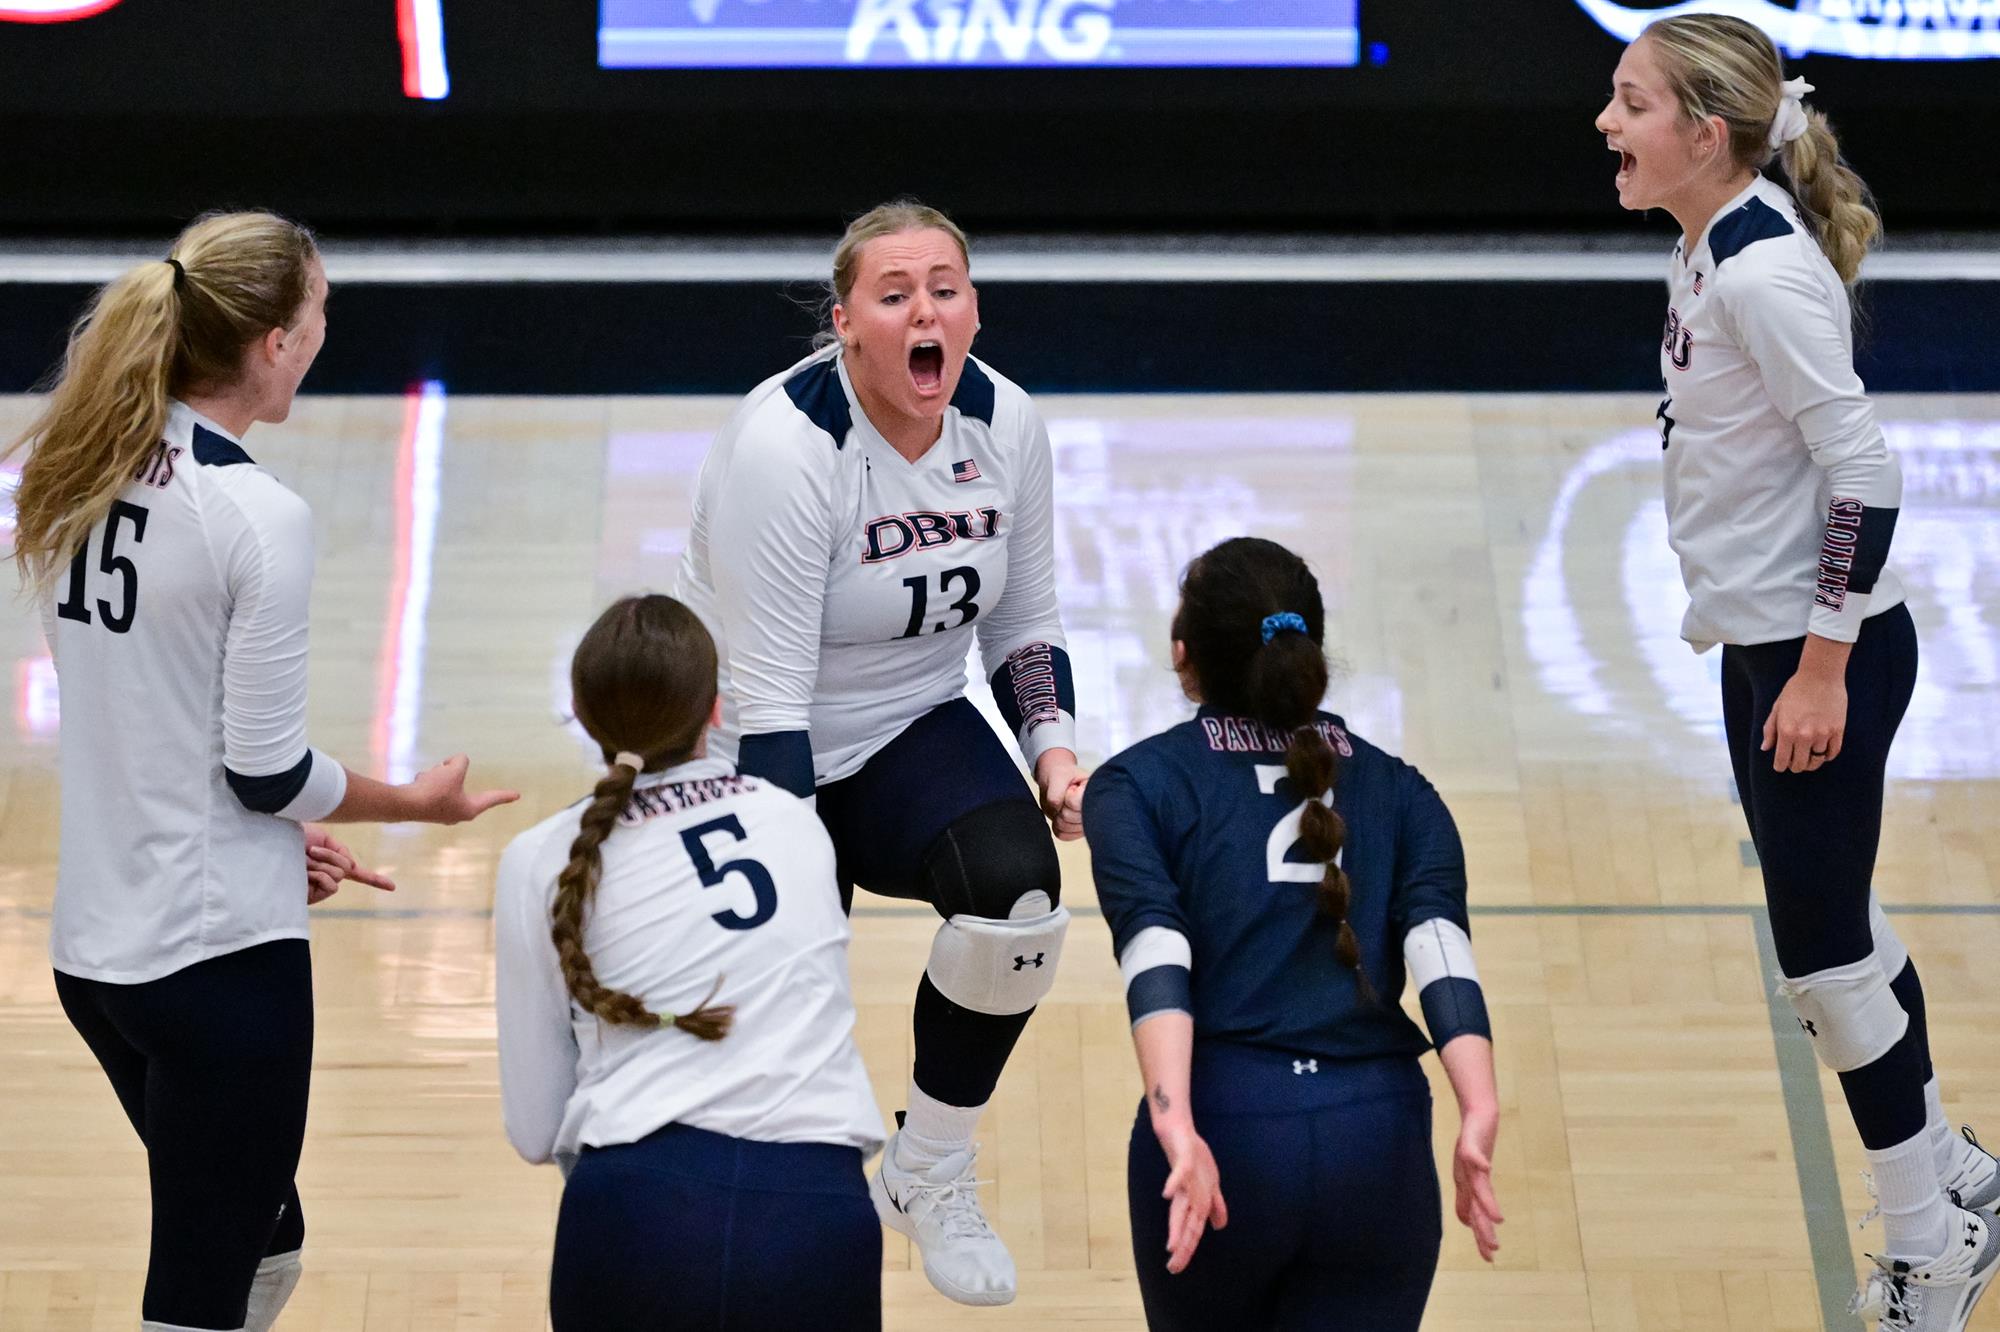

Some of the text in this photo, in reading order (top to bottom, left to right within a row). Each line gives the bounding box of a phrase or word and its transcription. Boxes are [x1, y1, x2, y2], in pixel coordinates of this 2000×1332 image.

[57, 499, 149, 634] 15
[861, 506, 1002, 565] DBU
[1811, 496, 1864, 613] PATRIOTS
[891, 565, 981, 640] 13
[1005, 641, 1060, 738] PATRIOTS
[679, 813, 778, 930] 5
[1254, 764, 1343, 882] 2
